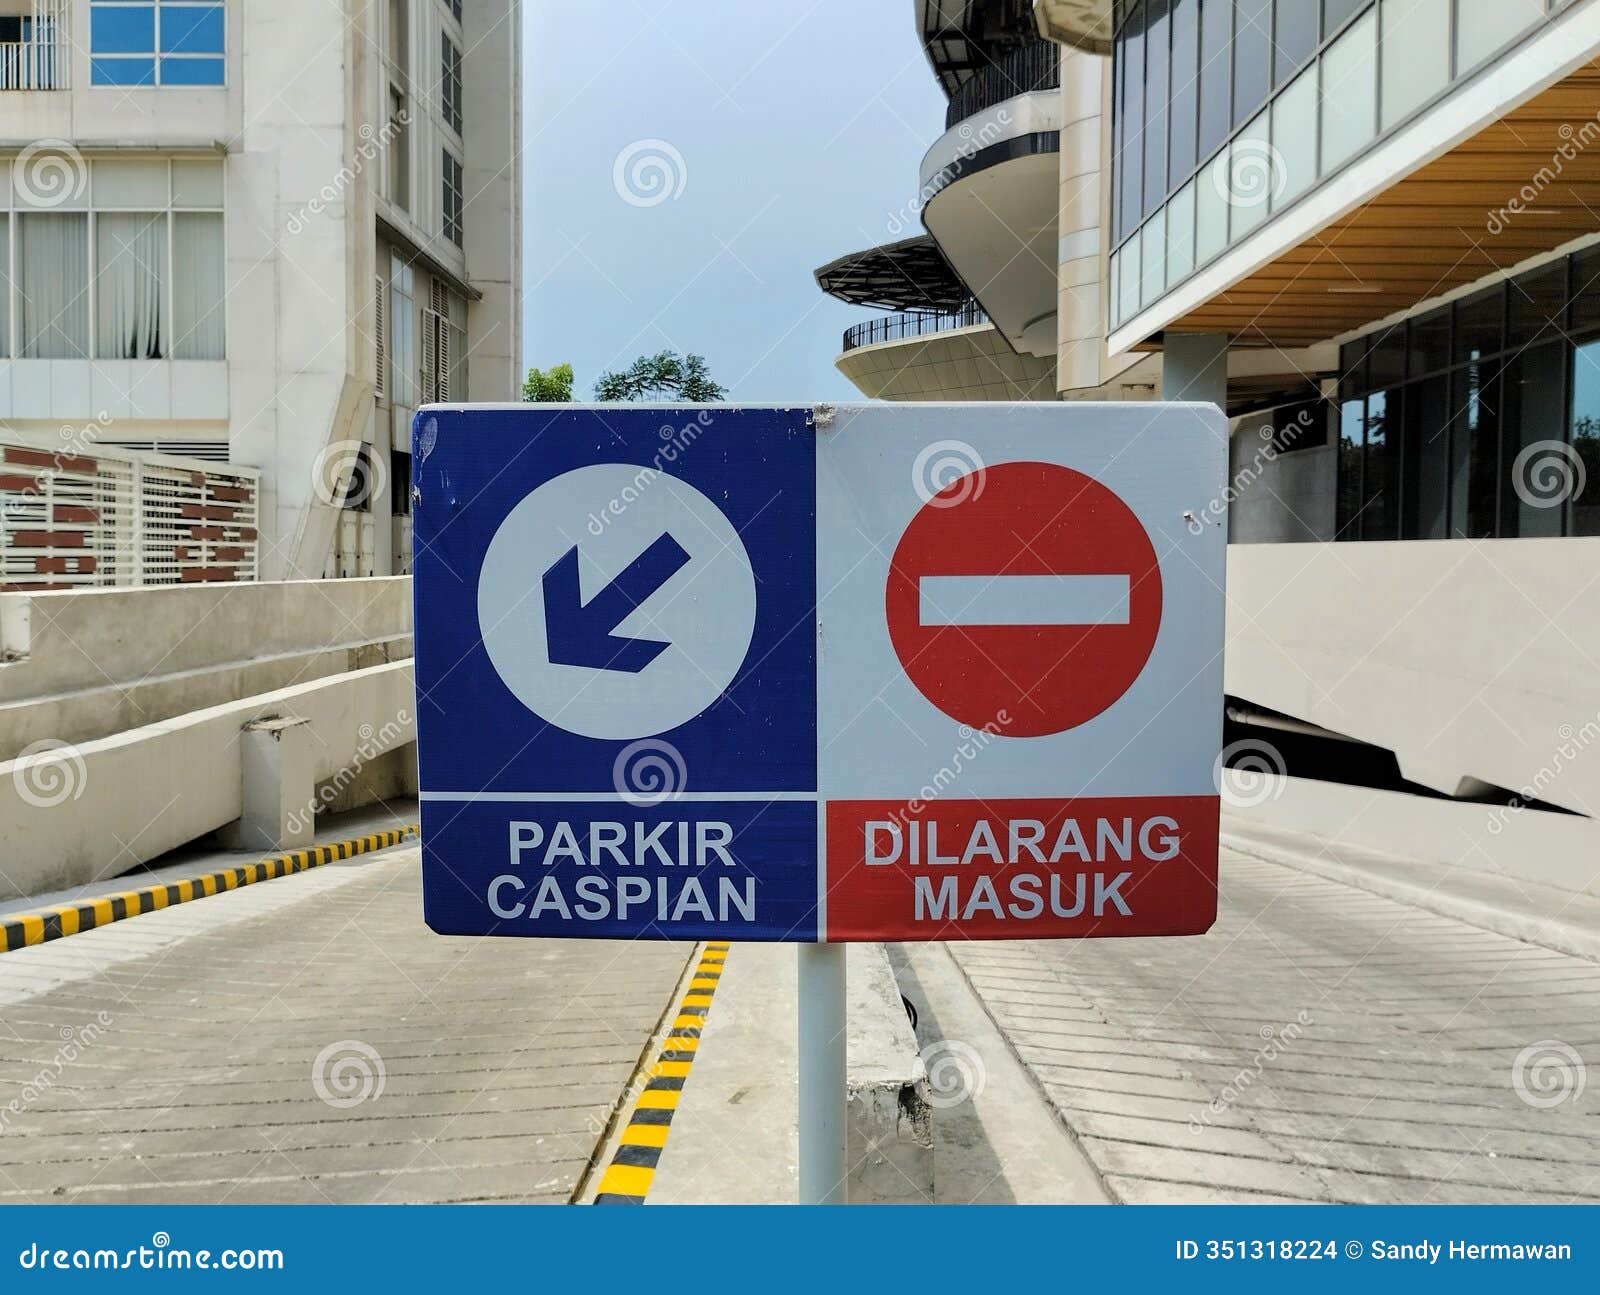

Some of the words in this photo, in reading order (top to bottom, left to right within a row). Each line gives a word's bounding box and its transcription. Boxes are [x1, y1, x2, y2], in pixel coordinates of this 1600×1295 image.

[508, 820, 736, 866] PARKIR
[864, 816, 1180, 865] DILARANG
[487, 874, 756, 922] CASPIAN
[914, 872, 1133, 920] MASUK
